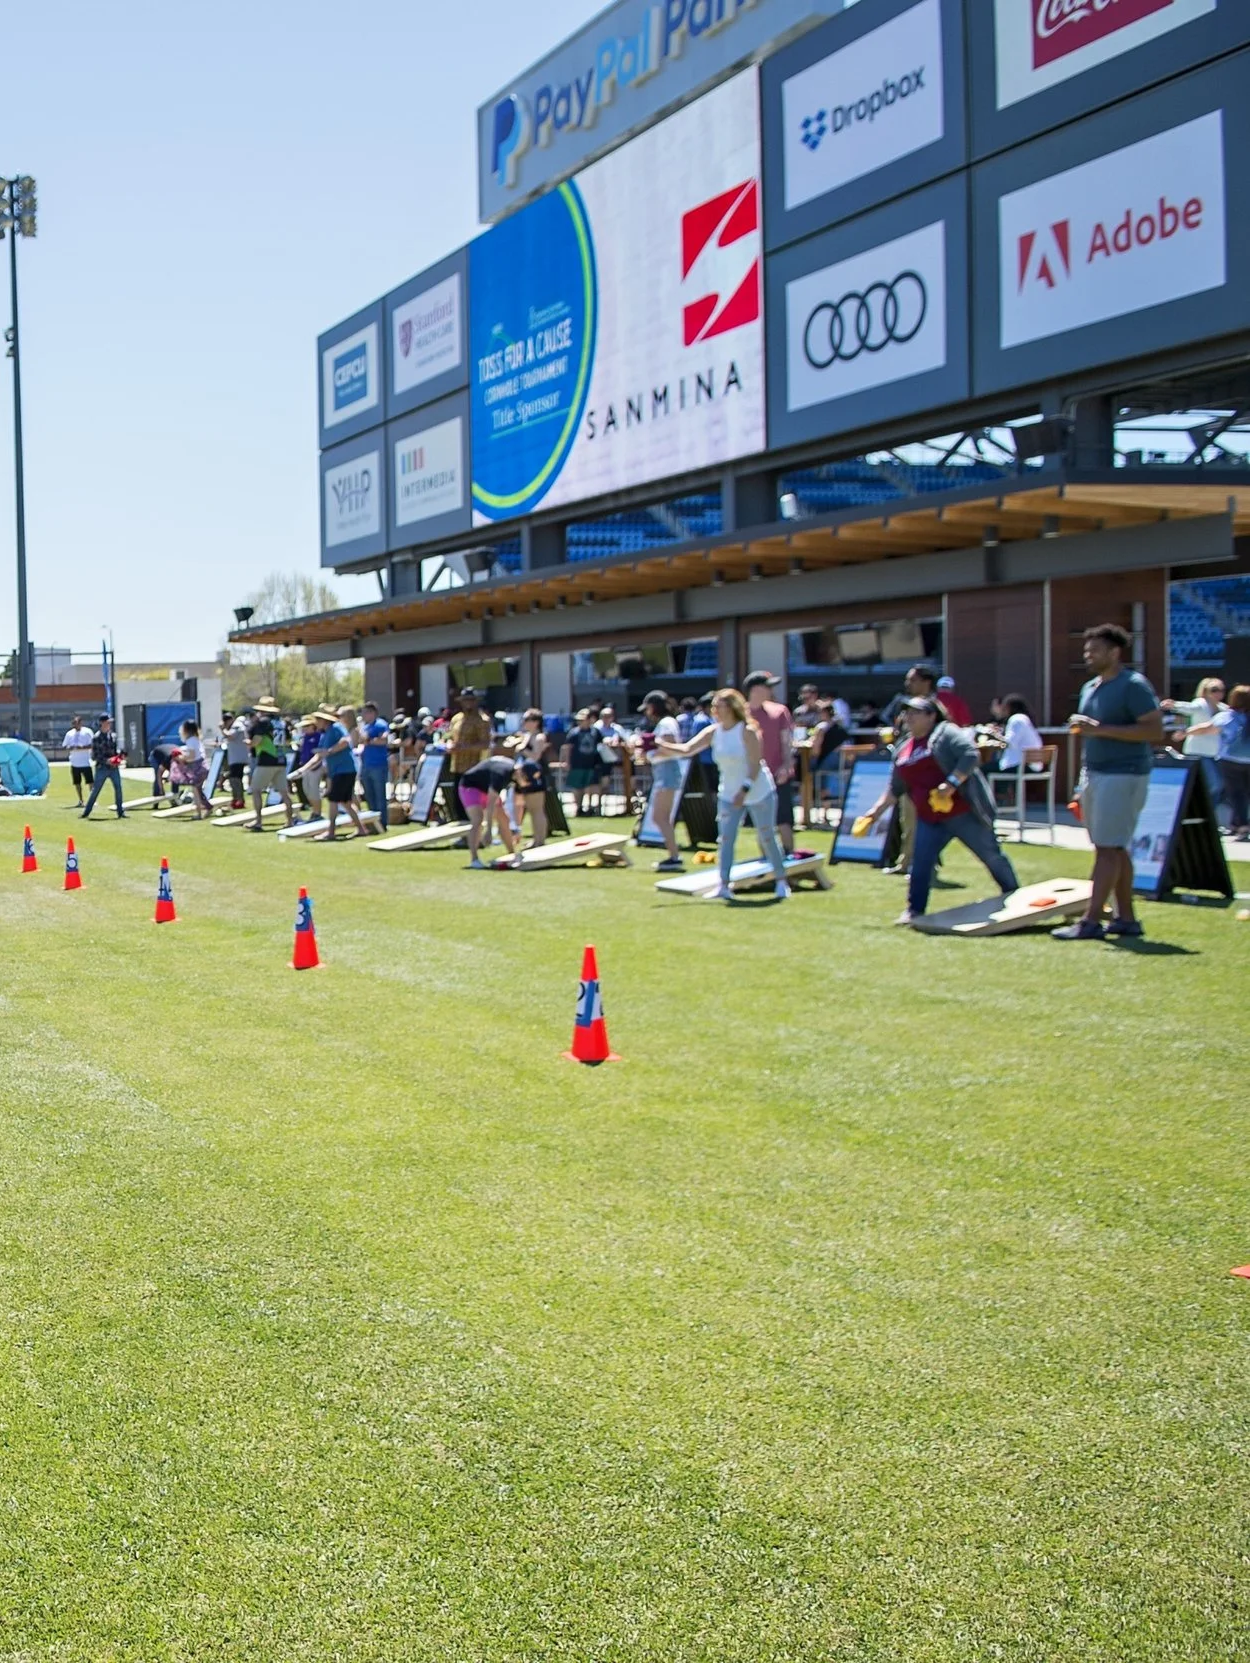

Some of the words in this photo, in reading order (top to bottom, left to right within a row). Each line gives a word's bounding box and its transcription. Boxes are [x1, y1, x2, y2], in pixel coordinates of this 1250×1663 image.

[534, 8, 653, 147] PayPal
[661, 0, 746, 56] Pa
[831, 65, 926, 134] Dropbox
[1086, 195, 1204, 264] Adobe
[477, 349, 504, 384] TOSS
[504, 339, 526, 373] FOR
[525, 335, 536, 364] A
[535, 317, 573, 360] CAUSE
[491, 403, 516, 429] Title
[515, 390, 561, 426] Sponsor
[586, 360, 742, 440] SANMINA
